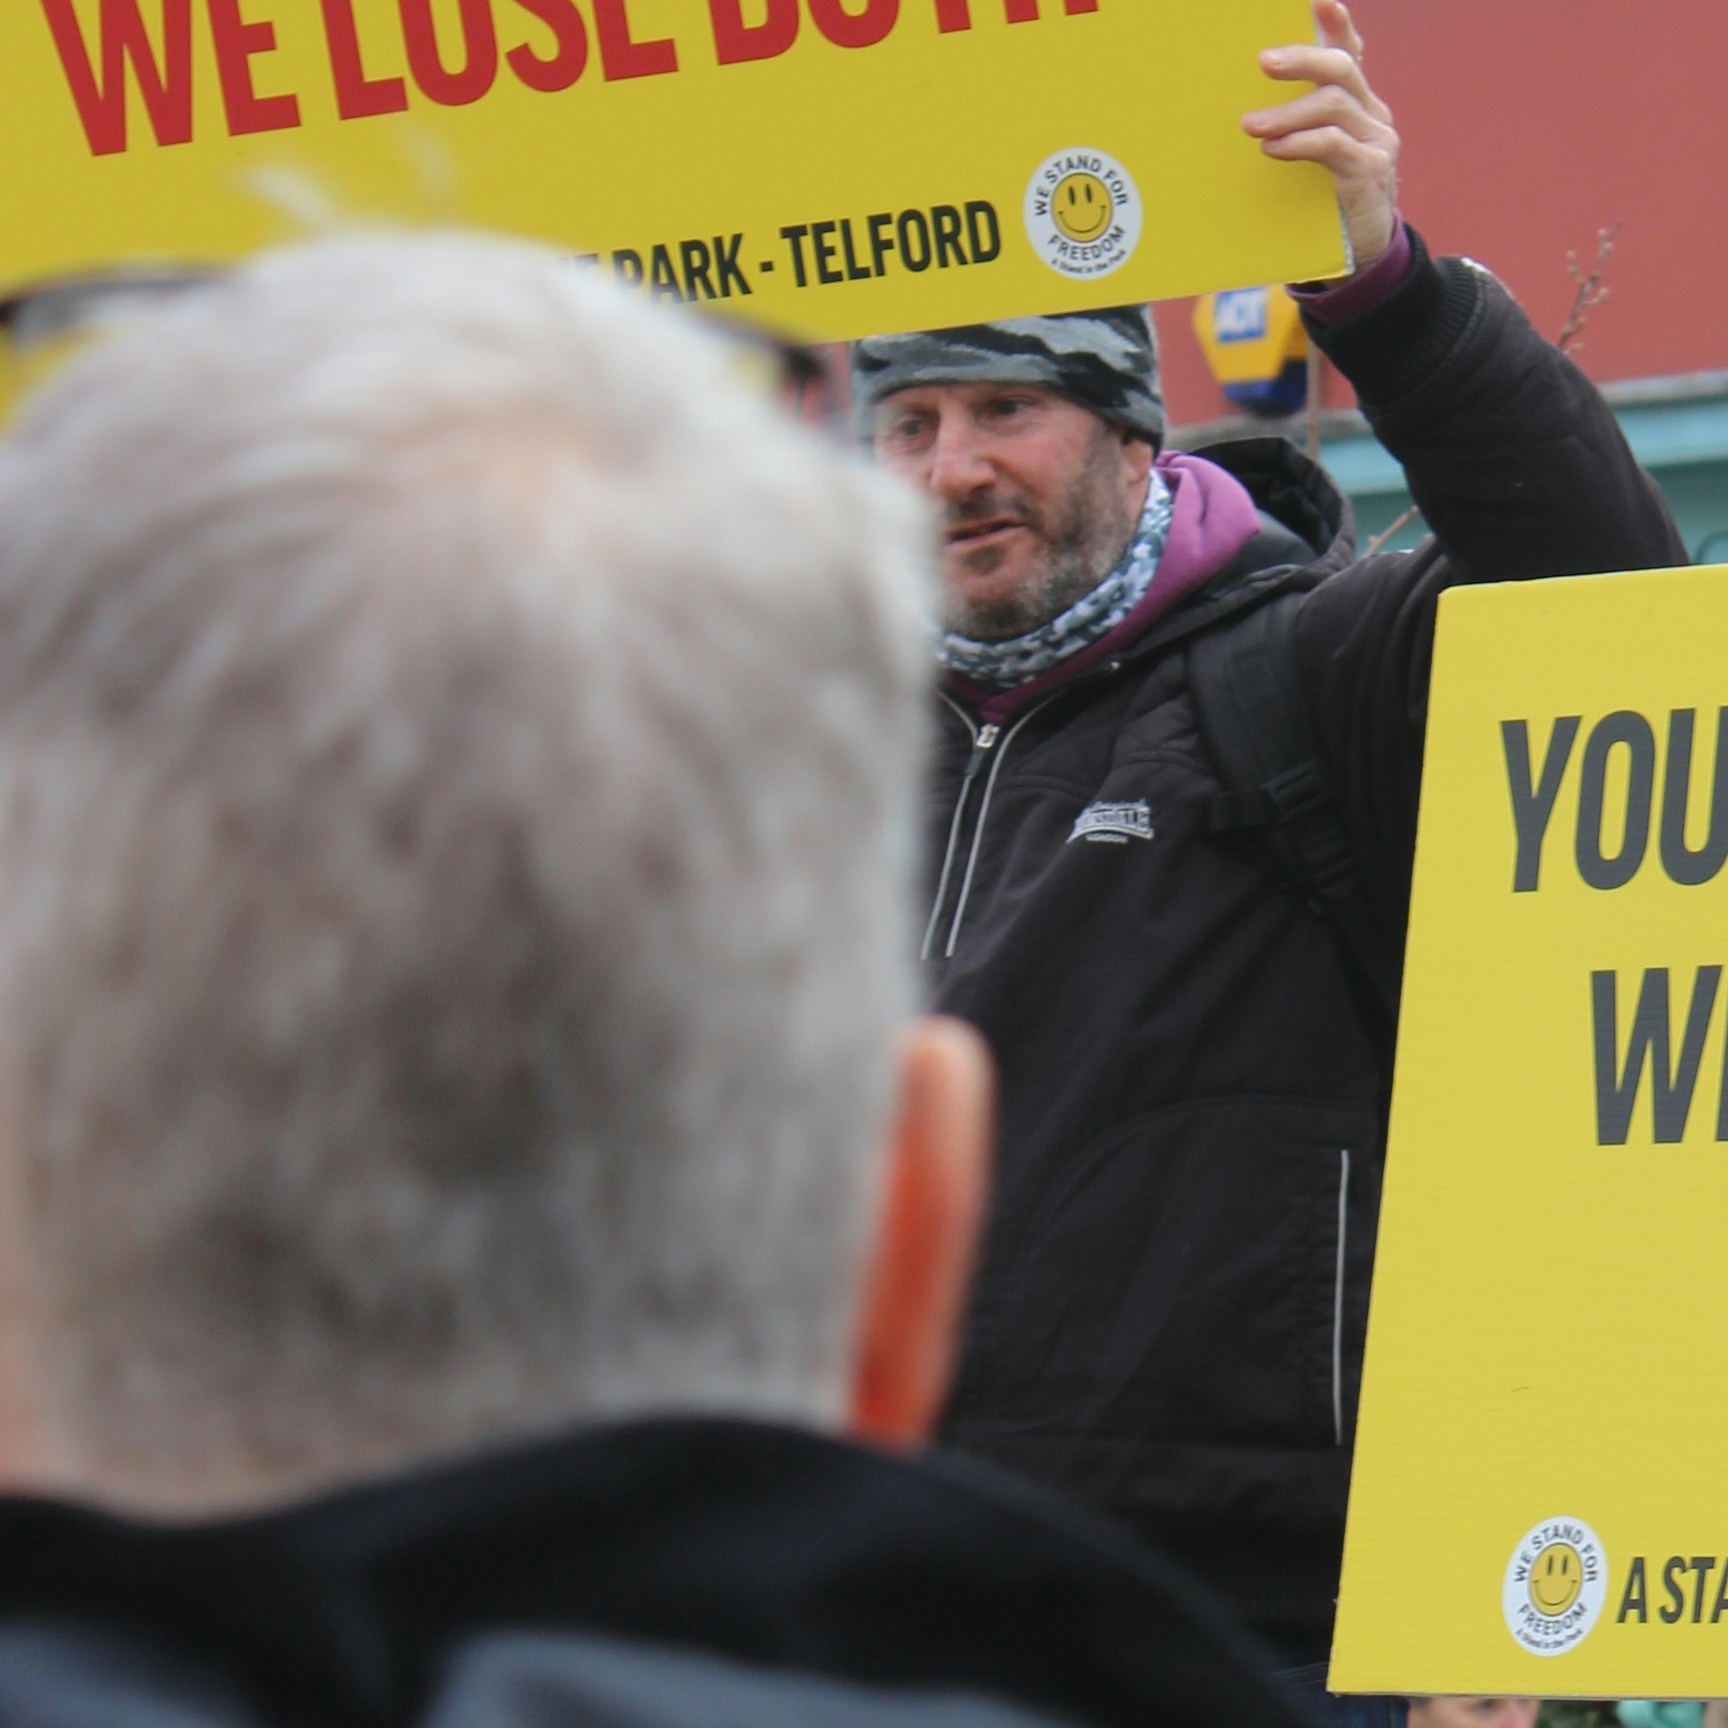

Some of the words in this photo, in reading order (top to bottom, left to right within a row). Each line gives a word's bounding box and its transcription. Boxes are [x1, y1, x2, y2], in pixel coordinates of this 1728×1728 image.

[1034, 186, 1050, 217] WE
[1044, 155, 1103, 185] STAND
[1103, 169, 1129, 206] FOR
[611, 234, 753, 304] PARK
[780, 200, 1001, 288] TELFORD
[1047, 225, 1125, 262] FREEDOM
[1513, 1549, 1533, 1583] WE
[1530, 1524, 1585, 1551] STAND
[1580, 1544, 1599, 1583] FOR
[1516, 1601, 1589, 1636] FREEDOM
[1616, 1556, 1648, 1624] A
